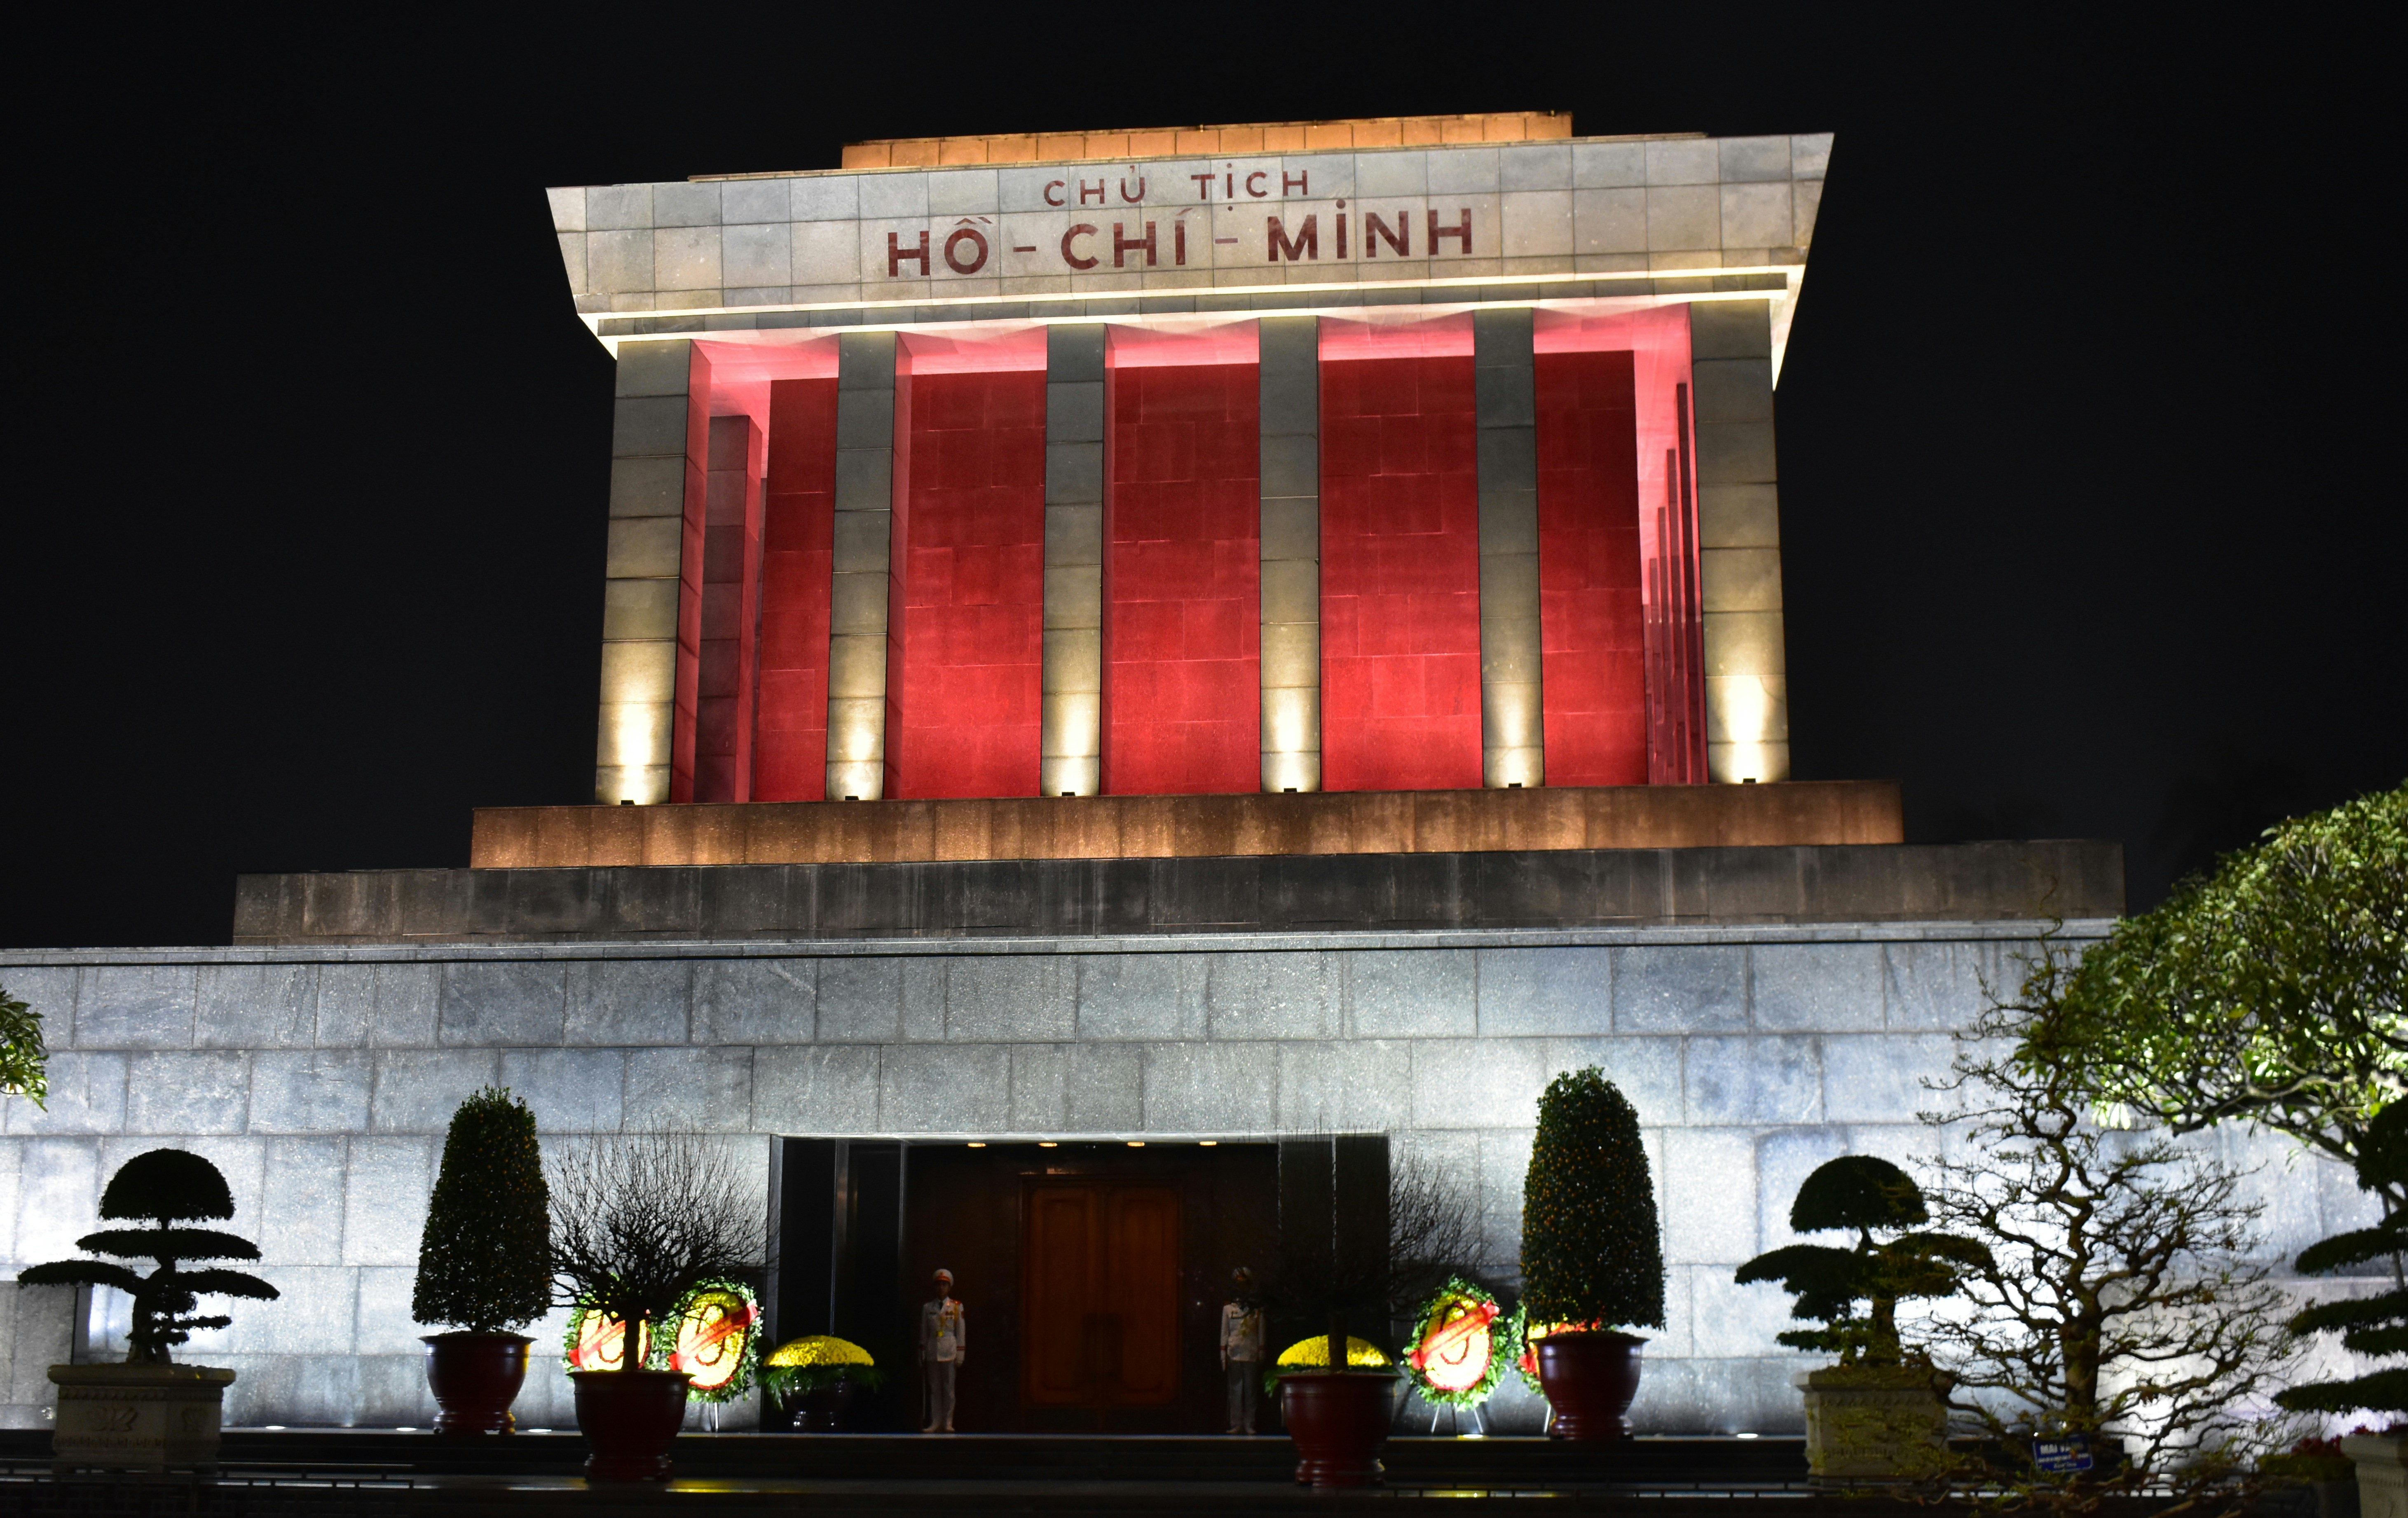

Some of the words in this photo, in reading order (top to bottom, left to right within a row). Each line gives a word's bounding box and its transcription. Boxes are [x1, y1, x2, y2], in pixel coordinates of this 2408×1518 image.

[1044, 165, 1145, 206] CHỦ
[888, 216, 993, 277] HỒ
[1061, 208, 1193, 270] CHÍ
